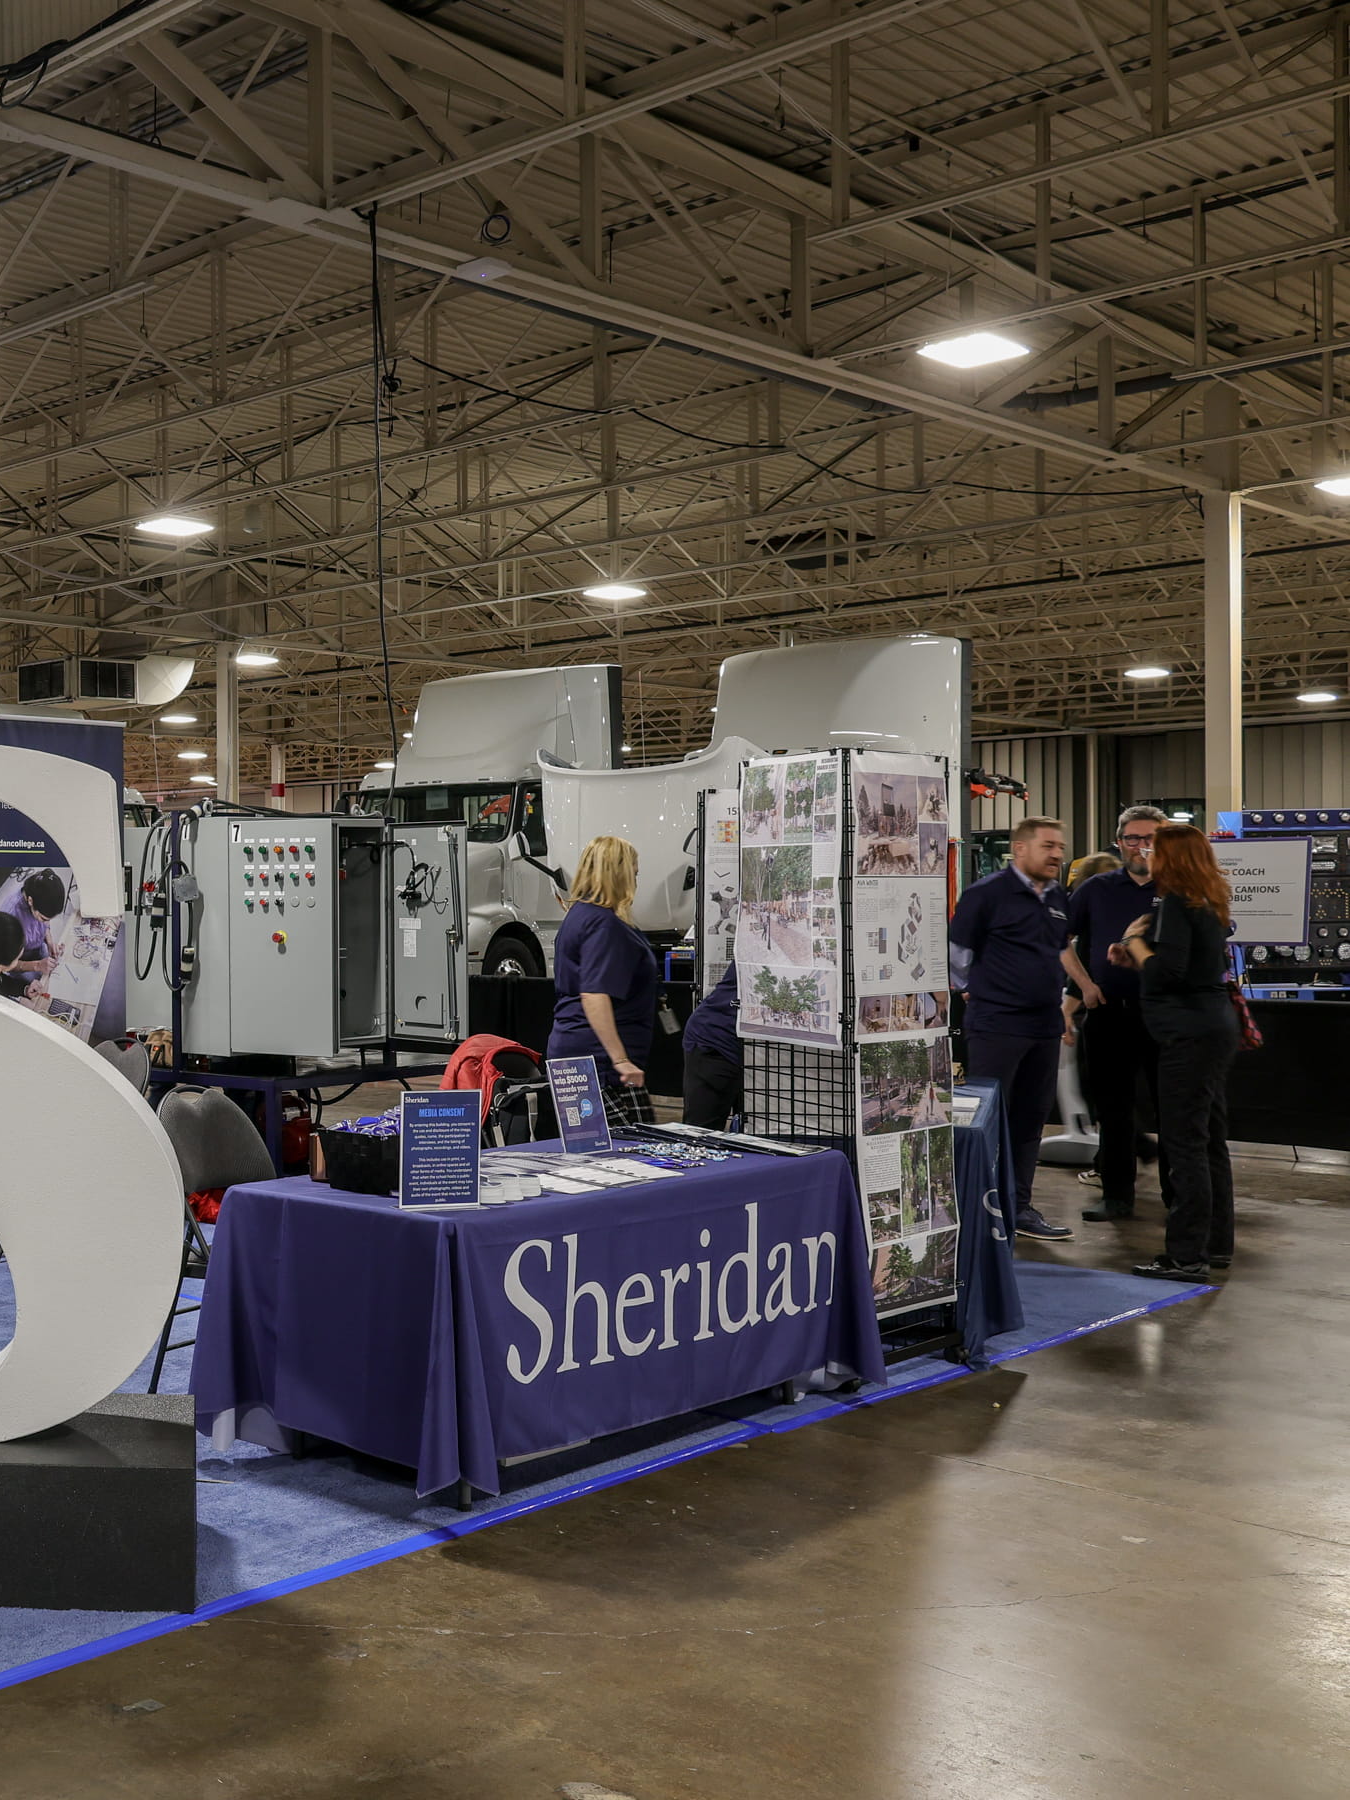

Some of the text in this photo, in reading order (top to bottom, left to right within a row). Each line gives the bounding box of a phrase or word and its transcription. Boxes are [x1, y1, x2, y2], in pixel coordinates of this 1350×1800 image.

[233, 824, 240, 842] 7
[1232, 868, 1265, 876] COACH
[418, 1108, 465, 1117] MEDIA CONSENT
[503, 1202, 836, 1384] Sheridan
